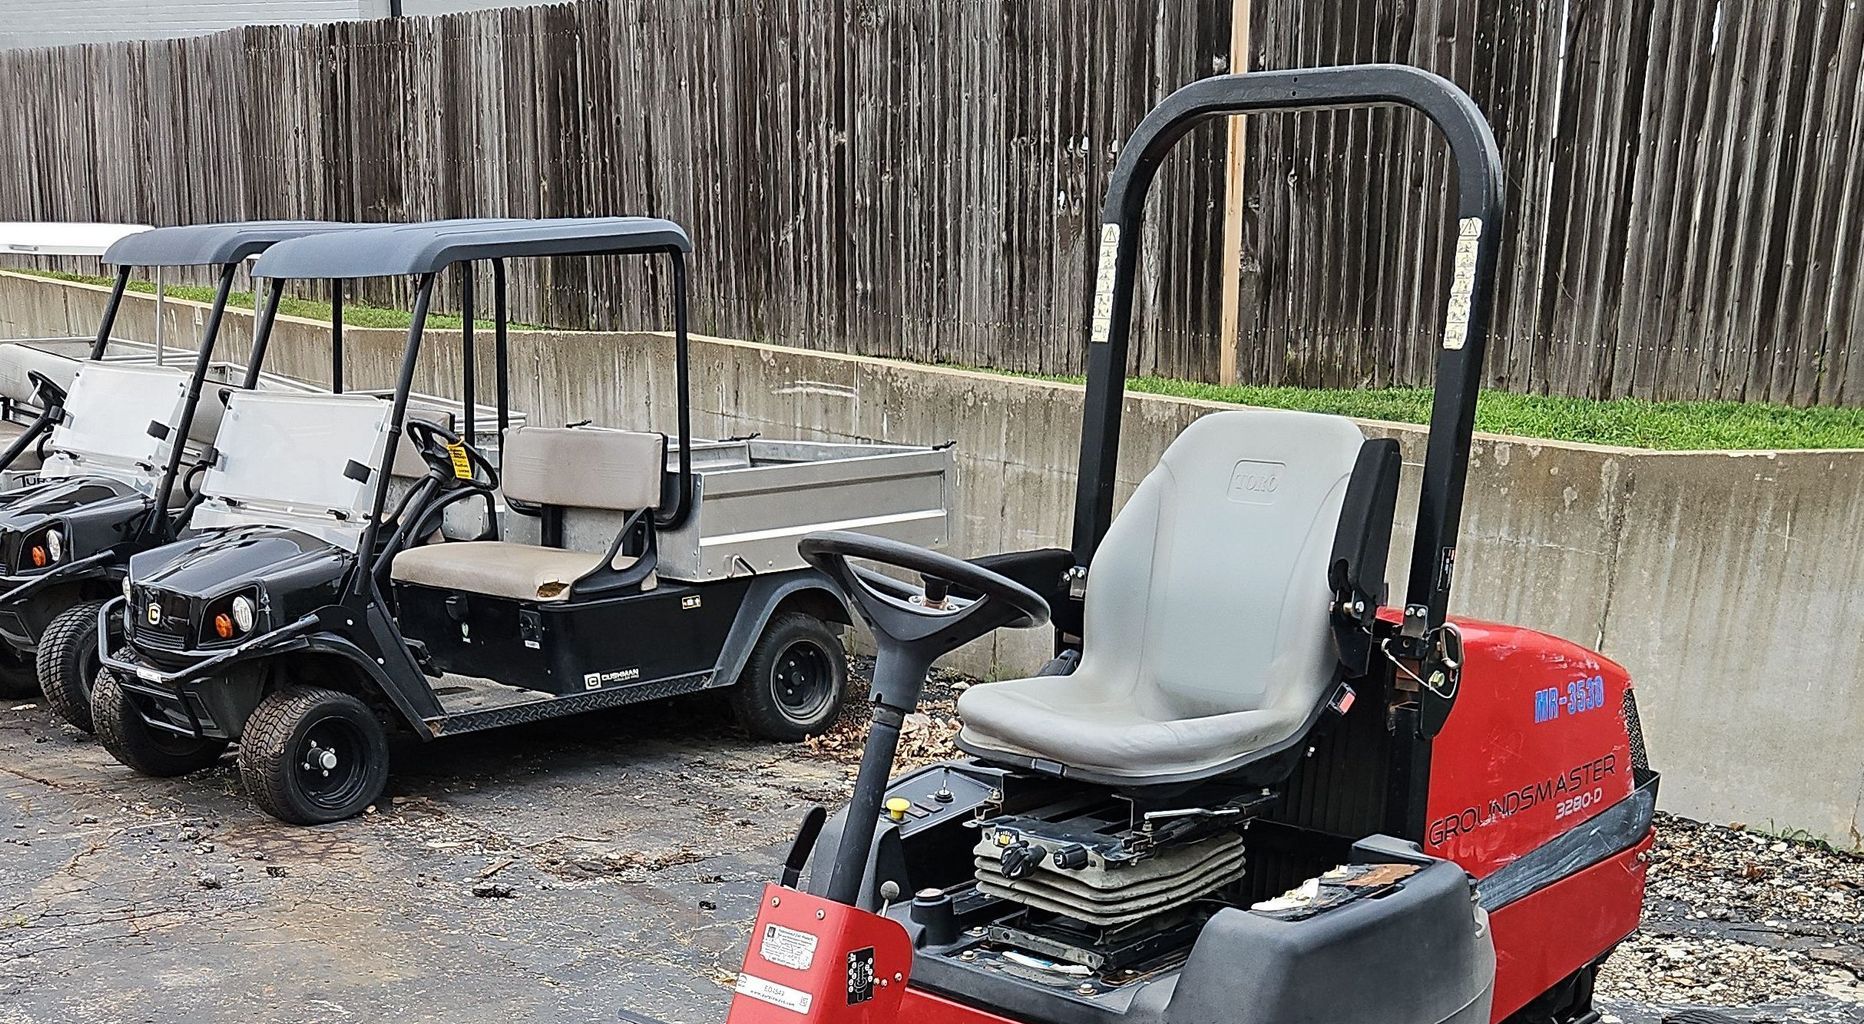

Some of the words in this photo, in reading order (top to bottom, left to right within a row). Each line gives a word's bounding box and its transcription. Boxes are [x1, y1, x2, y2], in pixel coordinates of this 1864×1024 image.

[601, 667, 639, 681] CUSHMAN
[1534, 674, 1605, 725] MR-3530
[1428, 752, 1616, 847] GROUNDSMASTER
